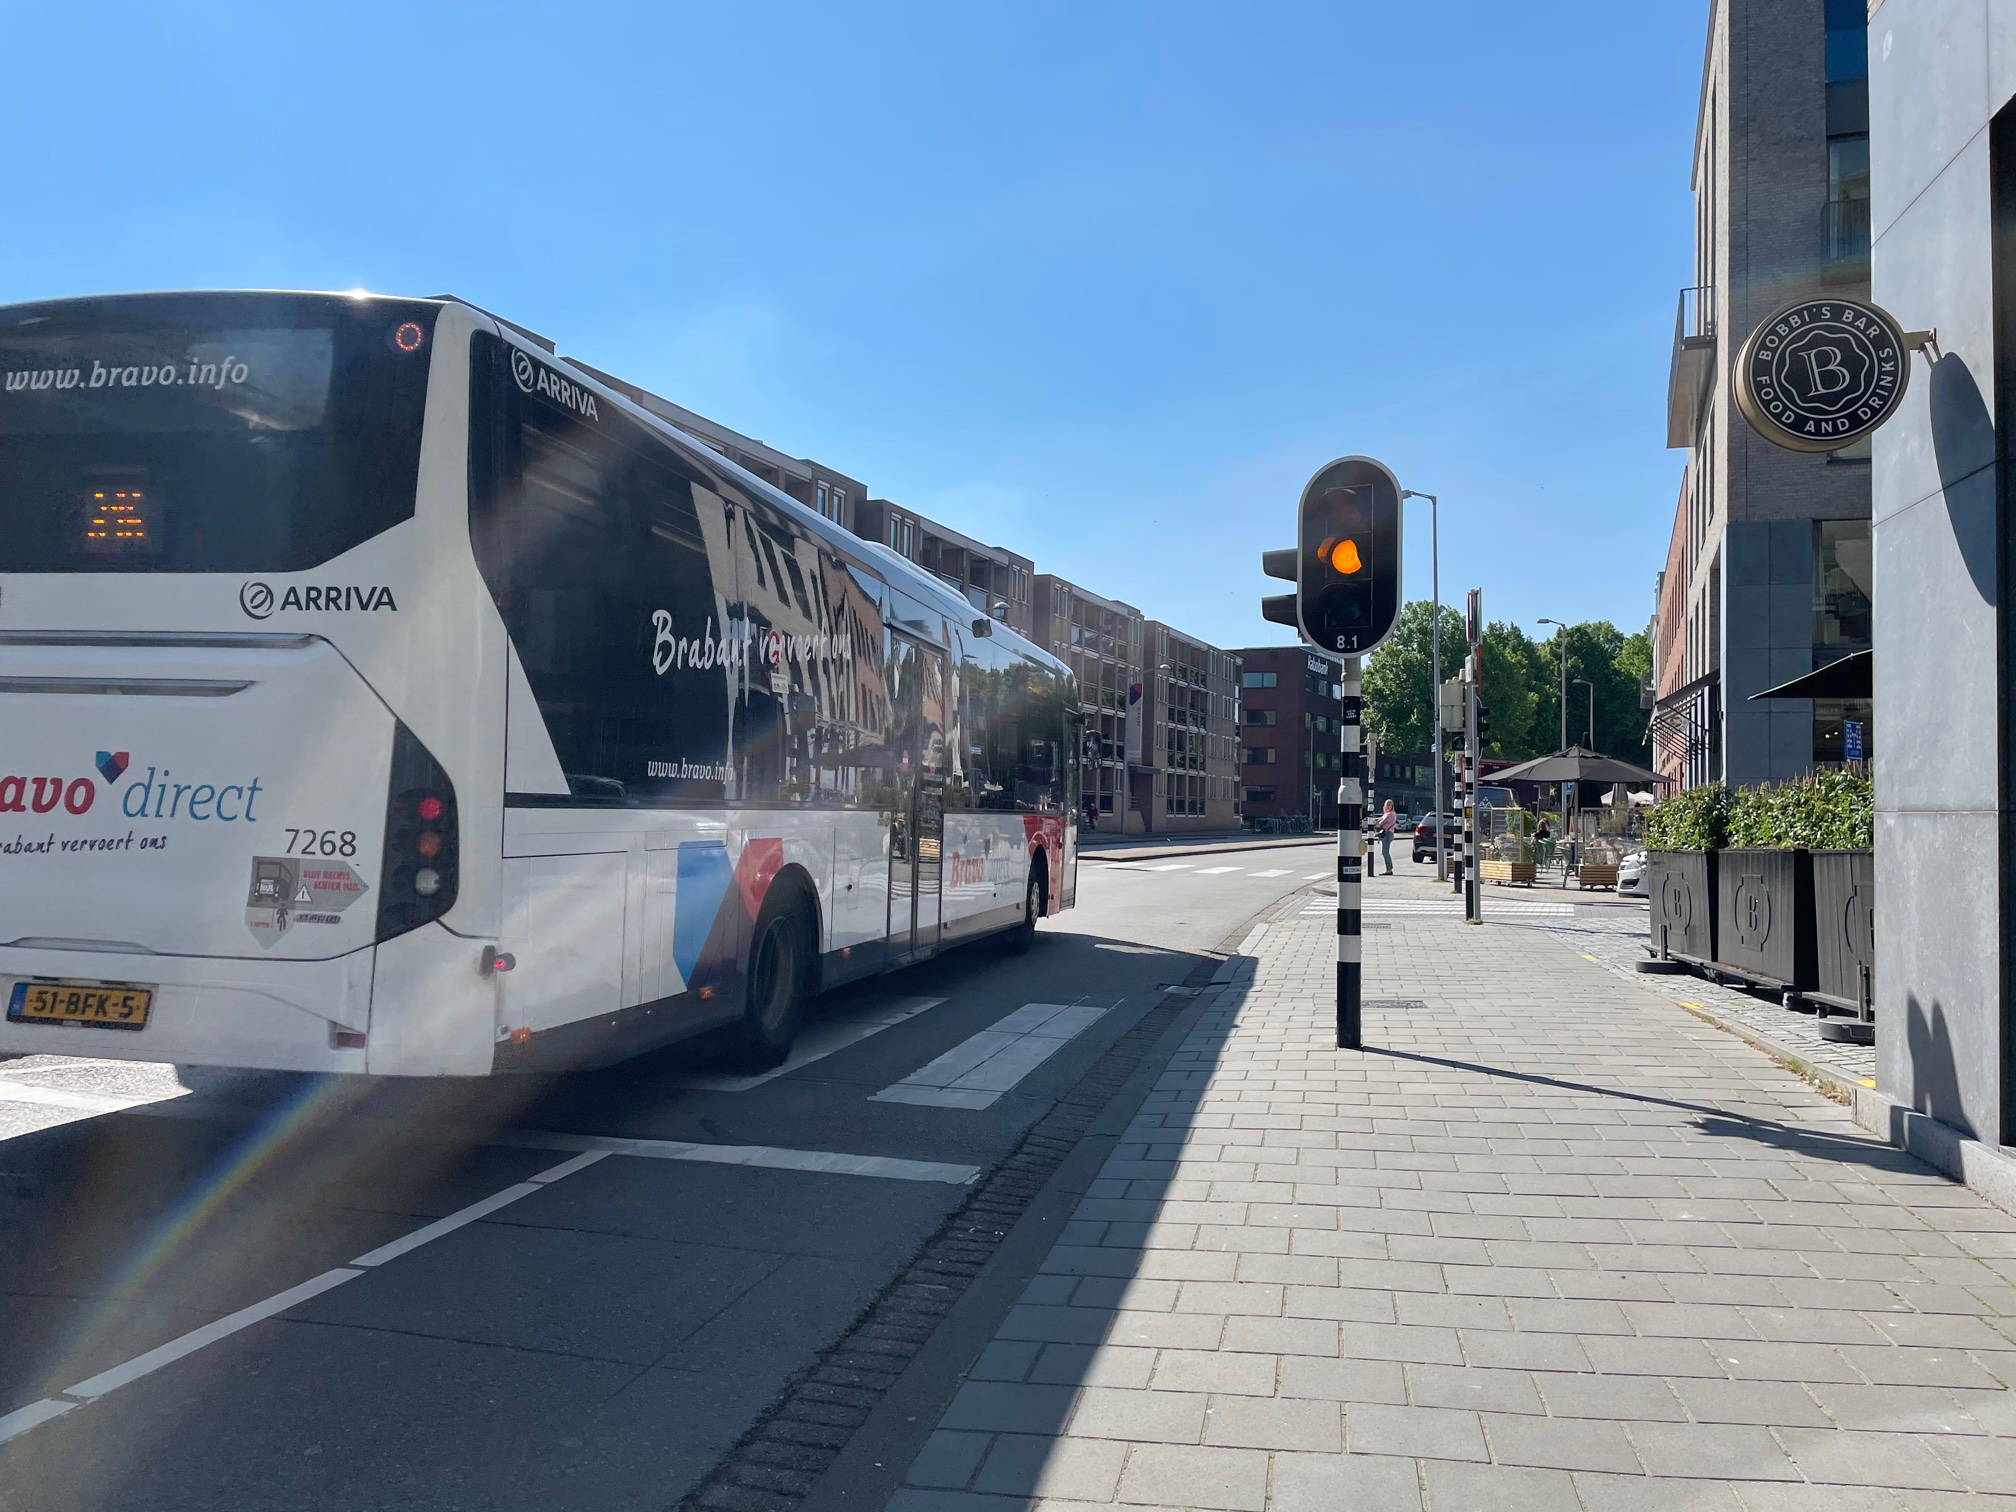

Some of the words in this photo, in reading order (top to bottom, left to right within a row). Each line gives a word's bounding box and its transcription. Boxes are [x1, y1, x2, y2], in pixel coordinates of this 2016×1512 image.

[1758, 306, 1832, 361] BOBBI'S
[1842, 309, 1880, 339] BAR
[5, 356, 249, 391] www.bravo.info
[1798, 346, 1850, 397] B
[536, 367, 599, 422] ARRIVA
[1757, 375, 1795, 424] FOOD
[1804, 418, 1850, 433] AND
[1857, 347, 1895, 421] DRINKS
[279, 586, 398, 612] ARRIVA
[651, 609, 752, 676] Brabant
[1336, 635, 1358, 649] 8.1
[1307, 654, 1329, 676] Rabobank
[647, 757, 734, 784] www.bravo.info
[122, 767, 263, 822] direct
[61, 830, 134, 852] vervoert
[140, 834, 168, 850] ons
[284, 828, 357, 857] 7268
[33, 990, 136, 1019] 51-BFK-5
